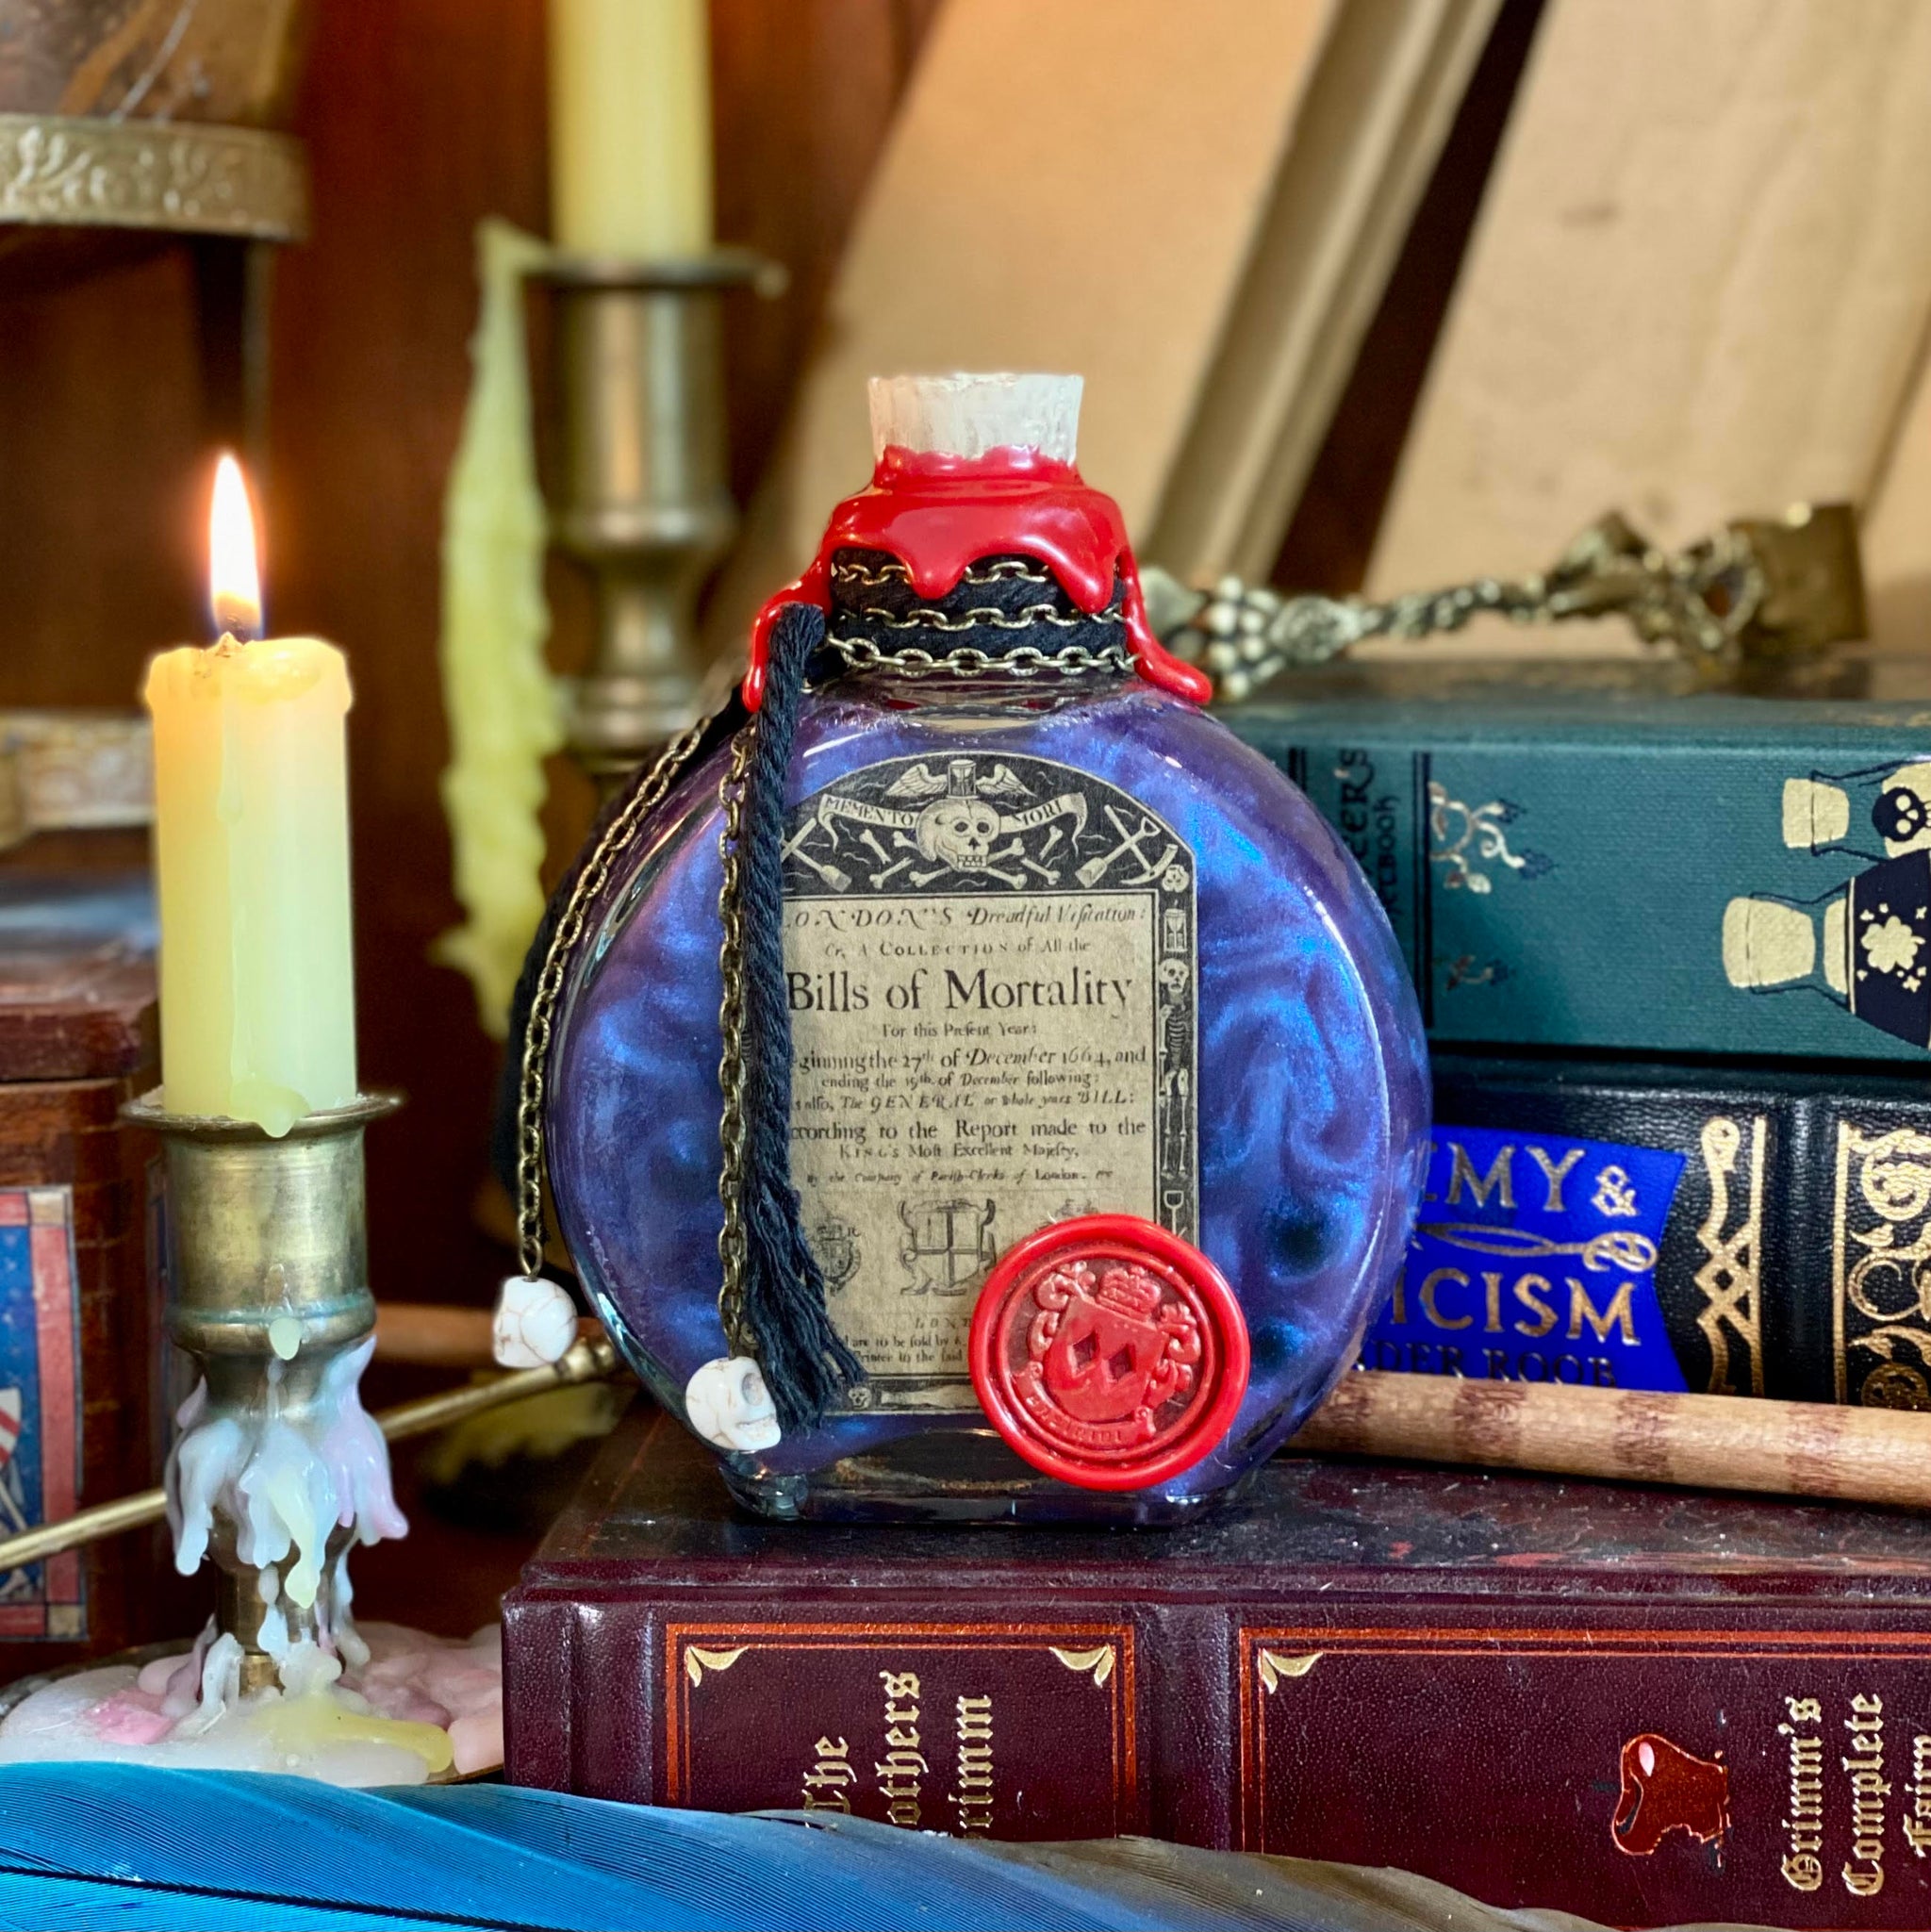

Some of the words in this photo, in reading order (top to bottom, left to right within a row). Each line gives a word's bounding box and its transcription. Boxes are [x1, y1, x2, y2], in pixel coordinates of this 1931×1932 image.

[824, 796, 915, 827] MEMENTO
[1012, 799, 1065, 827] MORI
[784, 905, 954, 933] ONDON'S
[966, 903, 1052, 929] Dreadful
[1017, 936, 1034, 952] of
[1040, 937, 1062, 953] All
[1068, 936, 1091, 952] the
[786, 969, 869, 1013] Bills
[885, 967, 929, 1011] of
[943, 965, 1133, 1019] Mortality
[882, 1023, 907, 1038] For
[913, 1022, 938, 1037] this
[795, 1049, 866, 1075] ginning
[869, 1049, 898, 1069] the
[939, 1047, 962, 1068] of
[966, 1046, 1057, 1066] December
[1114, 1045, 1147, 1065] and
[820, 1073, 869, 1094] ending
[875, 1072, 898, 1090] the
[937, 1070, 955, 1087] of
[960, 1071, 1020, 1087] December
[983, 1096, 999, 1106] or
[790, 1120, 866, 1146] ccording
[879, 1125, 899, 1140] to
[909, 1120, 938, 1140] the
[955, 1119, 1018, 1143] Report
[1031, 1117, 1078, 1137] made
[1088, 1121, 1108, 1136] to
[1117, 1115, 1147, 1136] the
[953, 1142, 1013, 1158] Excellent
[1590, 1164, 1642, 1217] &
[893, 1335, 906, 1347] be
[916, 1349, 935, 1362] the
[1358, 1339, 1465, 1379] DER
[1481, 1346, 1617, 1389] ROOB
[873, 1668, 930, 1826] others
[947, 1693, 995, 1833] rimm
[1777, 1695, 1824, 1892] Grimm's
[1840, 1692, 1892, 1897] Complete
